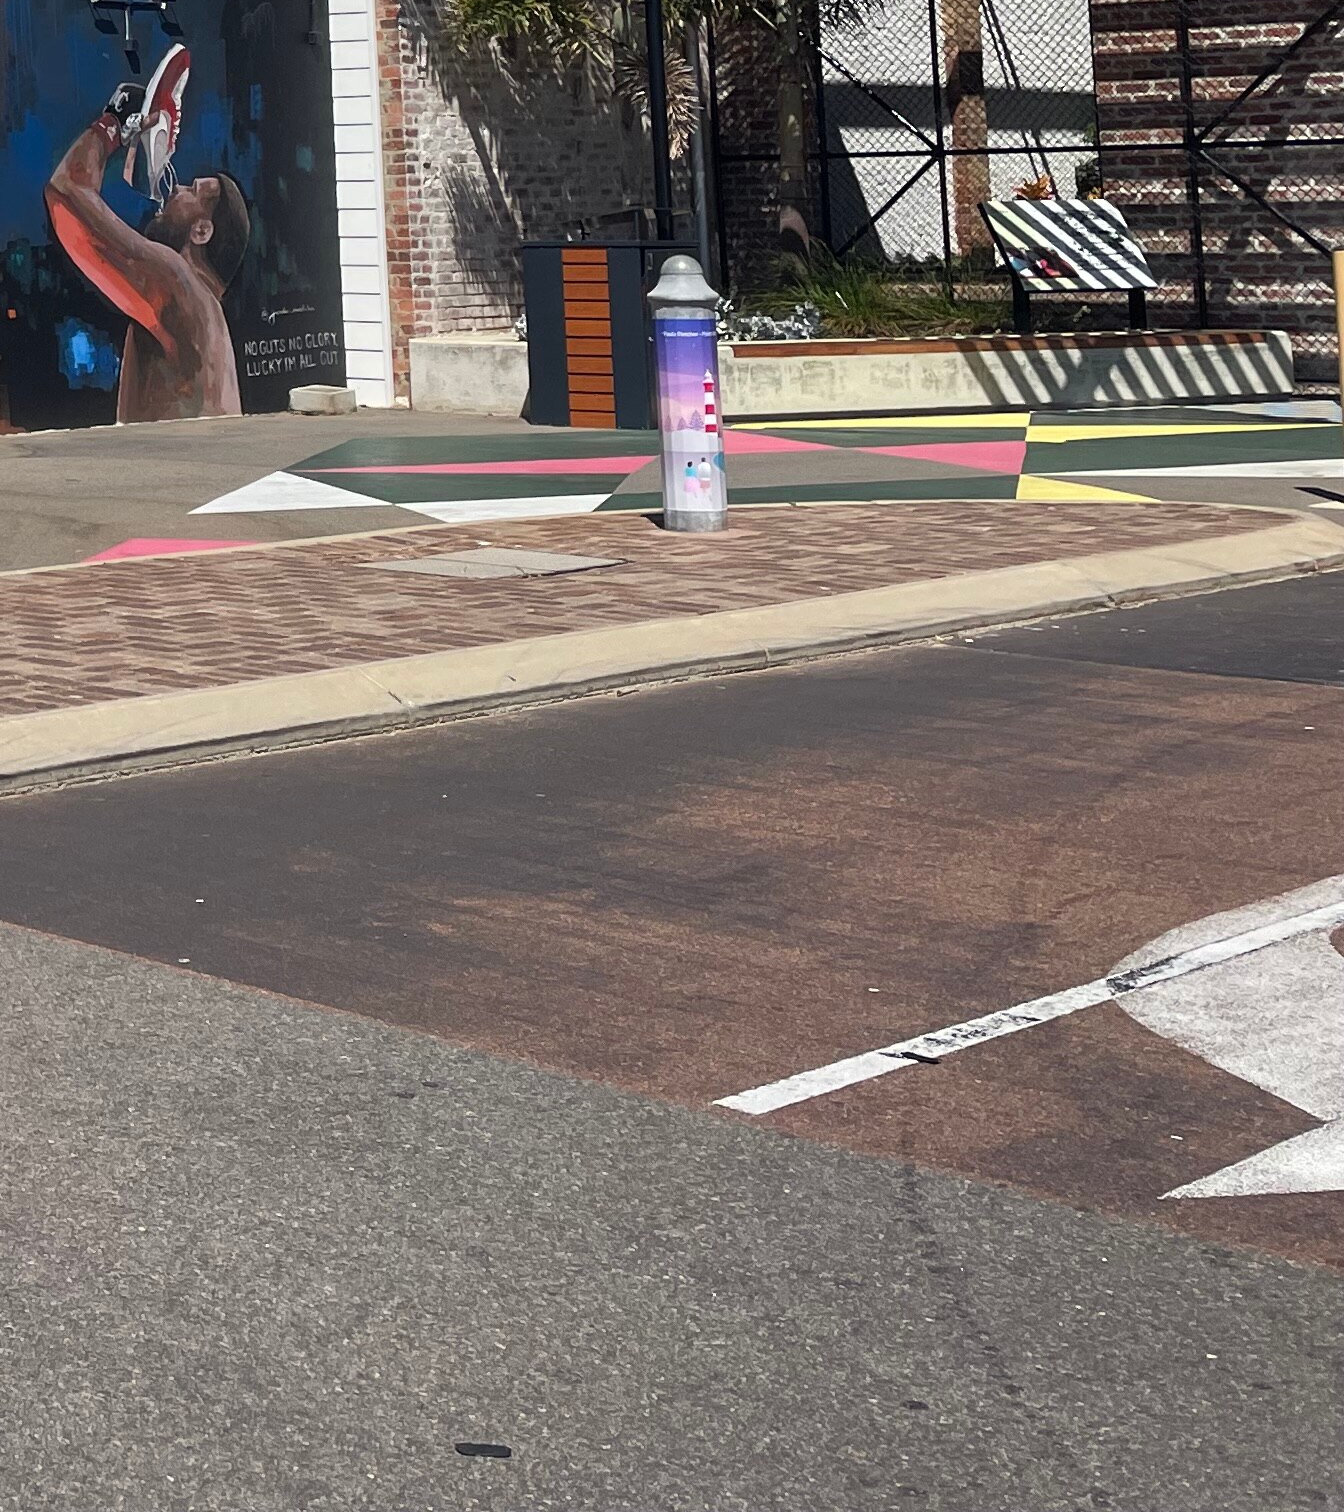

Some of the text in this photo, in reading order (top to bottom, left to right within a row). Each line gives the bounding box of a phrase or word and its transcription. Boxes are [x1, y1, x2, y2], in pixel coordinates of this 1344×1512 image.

[244, 340, 258, 356] NO
[258, 339, 287, 355] GUTS
[288, 336, 303, 351] NO
[246, 357, 282, 377] LUCKY
[299, 353, 316, 369] ALL
